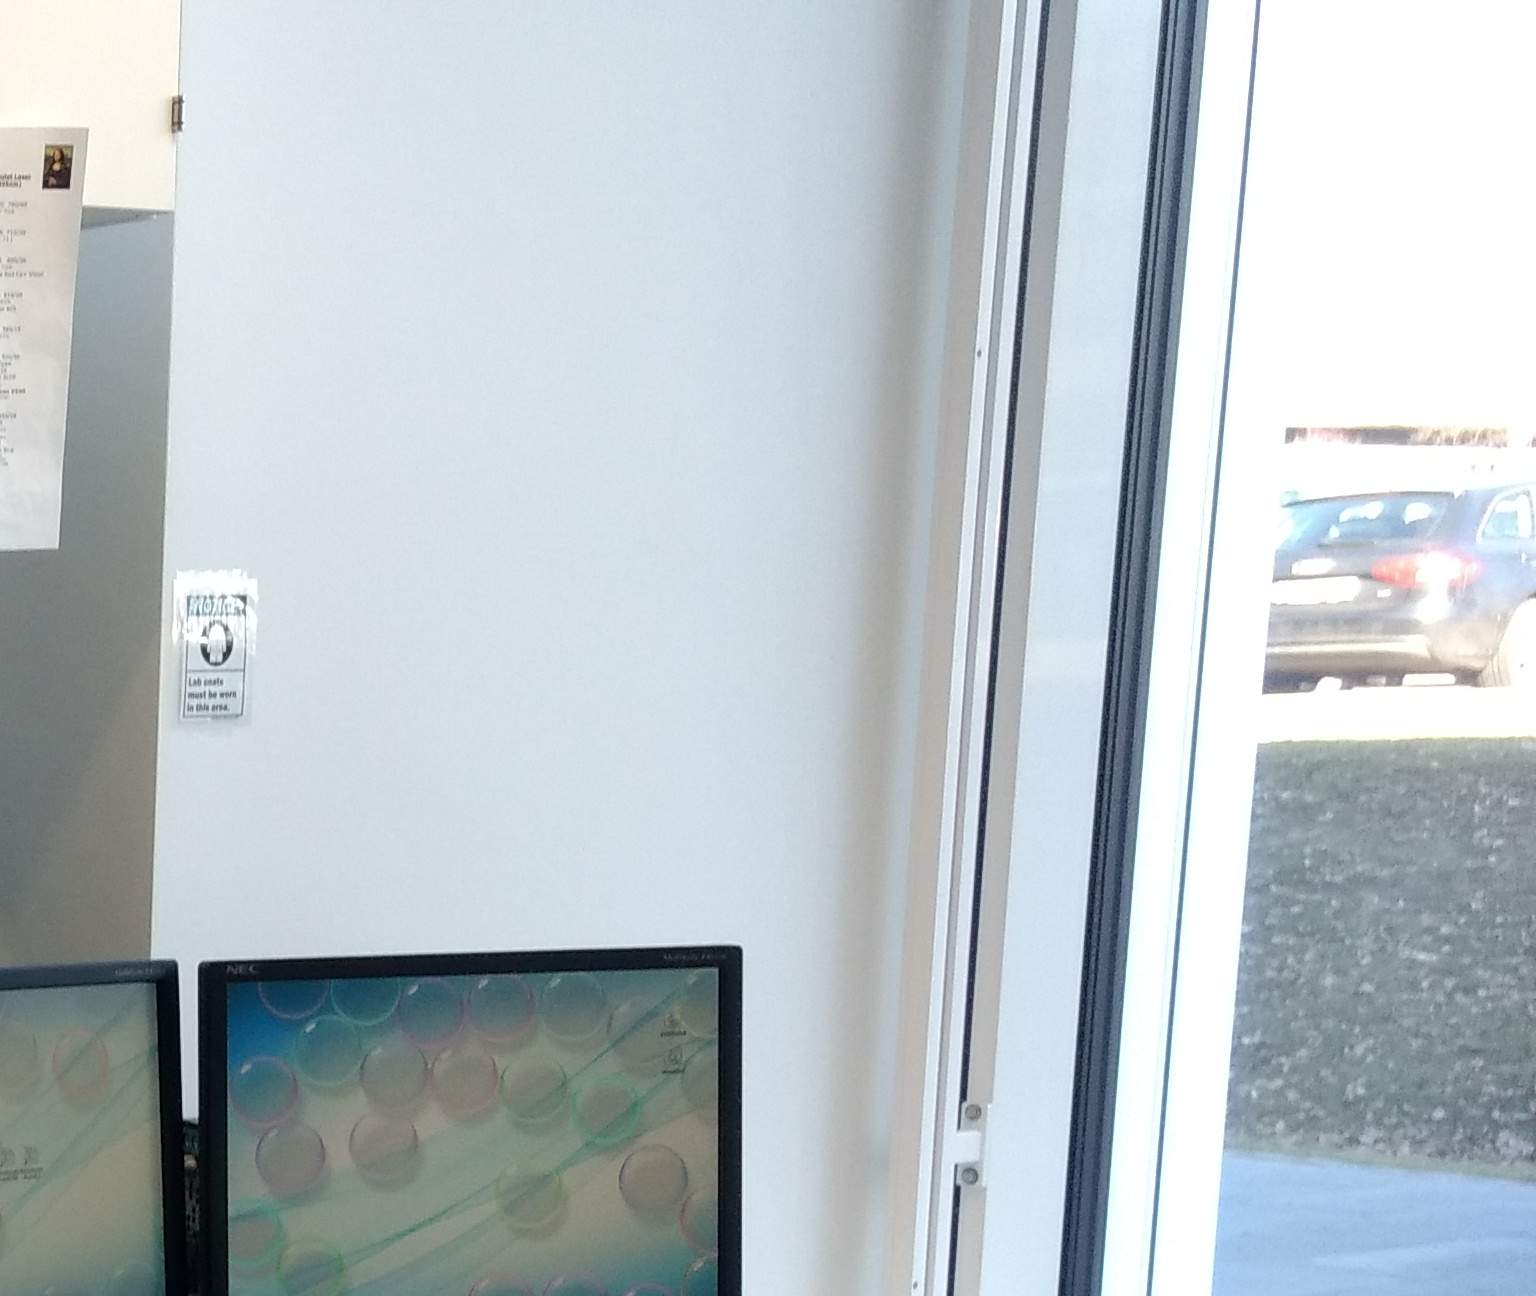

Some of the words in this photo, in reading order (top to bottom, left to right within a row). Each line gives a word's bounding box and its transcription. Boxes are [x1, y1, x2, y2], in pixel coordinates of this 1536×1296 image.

[188, 677, 202, 686] Lab
[188, 691, 206, 700] must
[208, 690, 218, 698] be
[220, 690, 237, 698] worn
[196, 704, 210, 712] this
